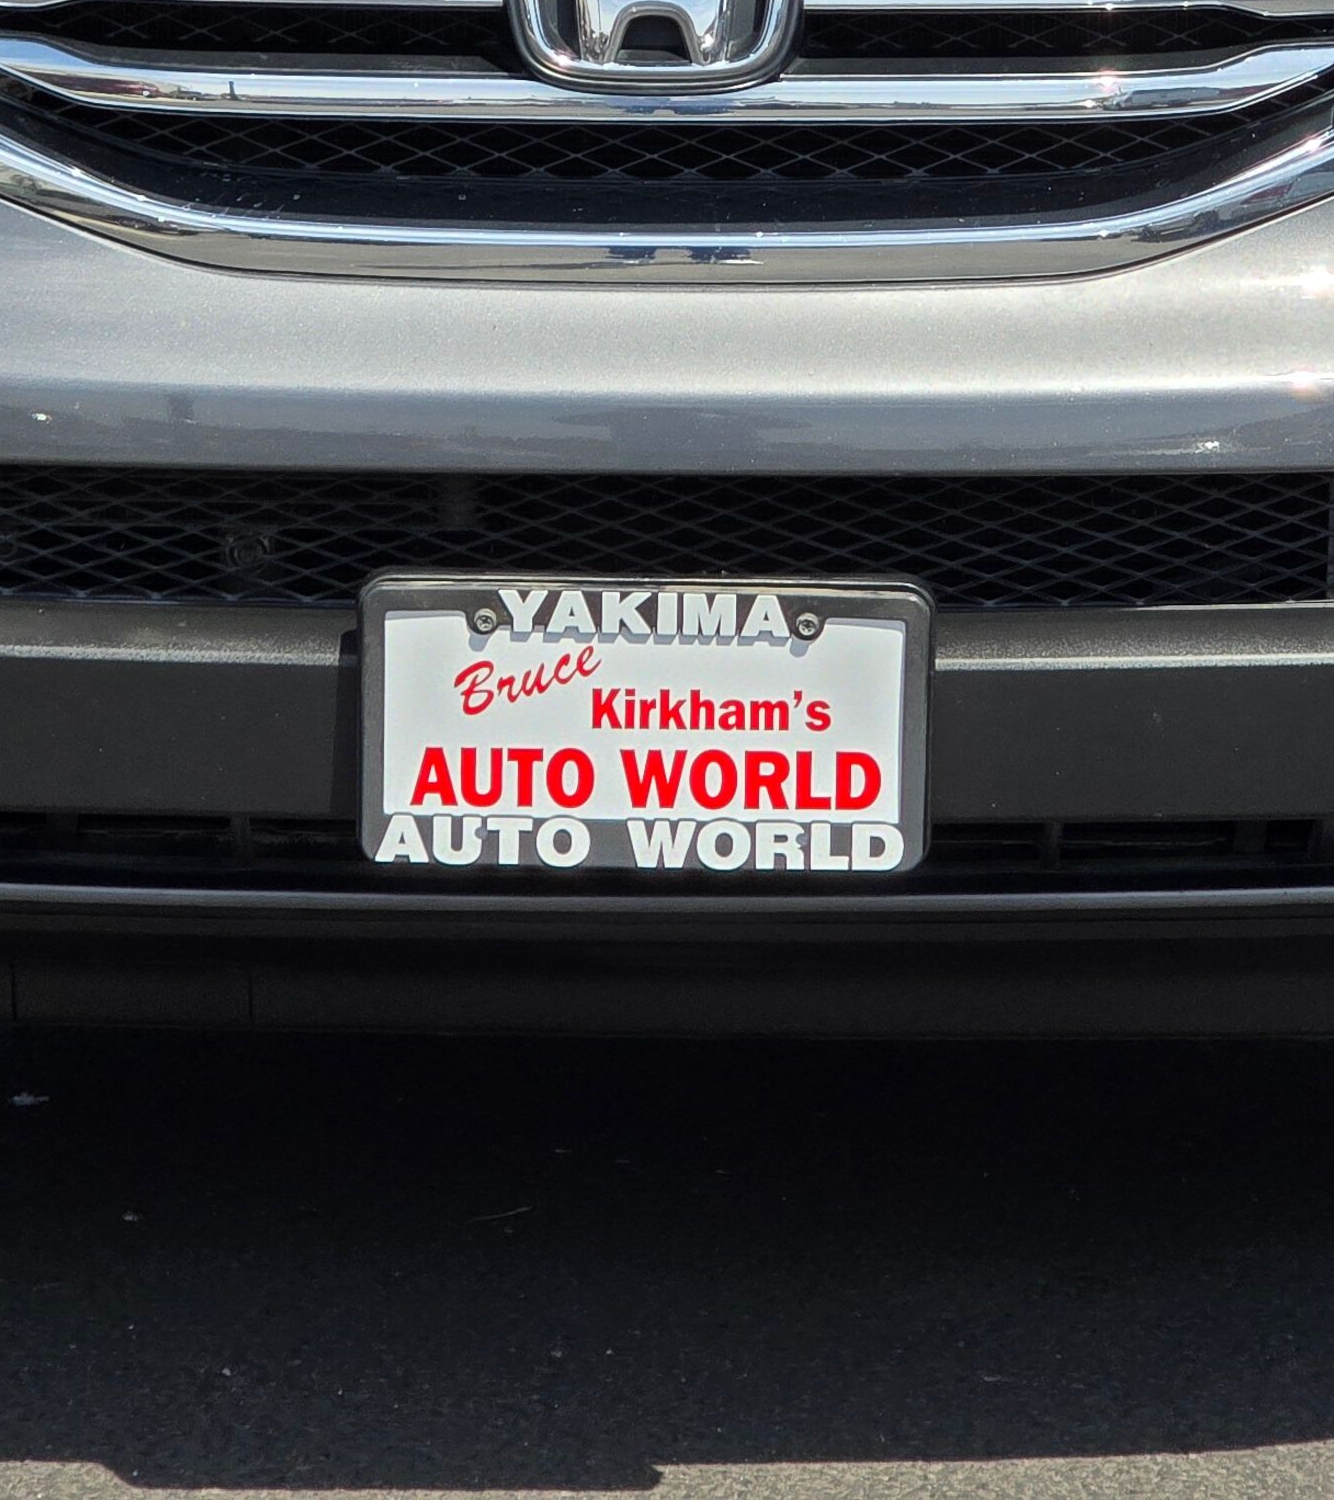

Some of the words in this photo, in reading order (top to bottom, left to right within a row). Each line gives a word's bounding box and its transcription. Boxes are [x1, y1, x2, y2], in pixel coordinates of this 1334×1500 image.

[497, 588, 791, 639] YAKIMA
[453, 645, 602, 716] Bruce
[591, 687, 832, 732] Kirkham's
[409, 746, 596, 809] AUTO
[619, 748, 882, 811] WORLD
[374, 812, 592, 868] AUTO
[625, 817, 905, 872] WORLD
